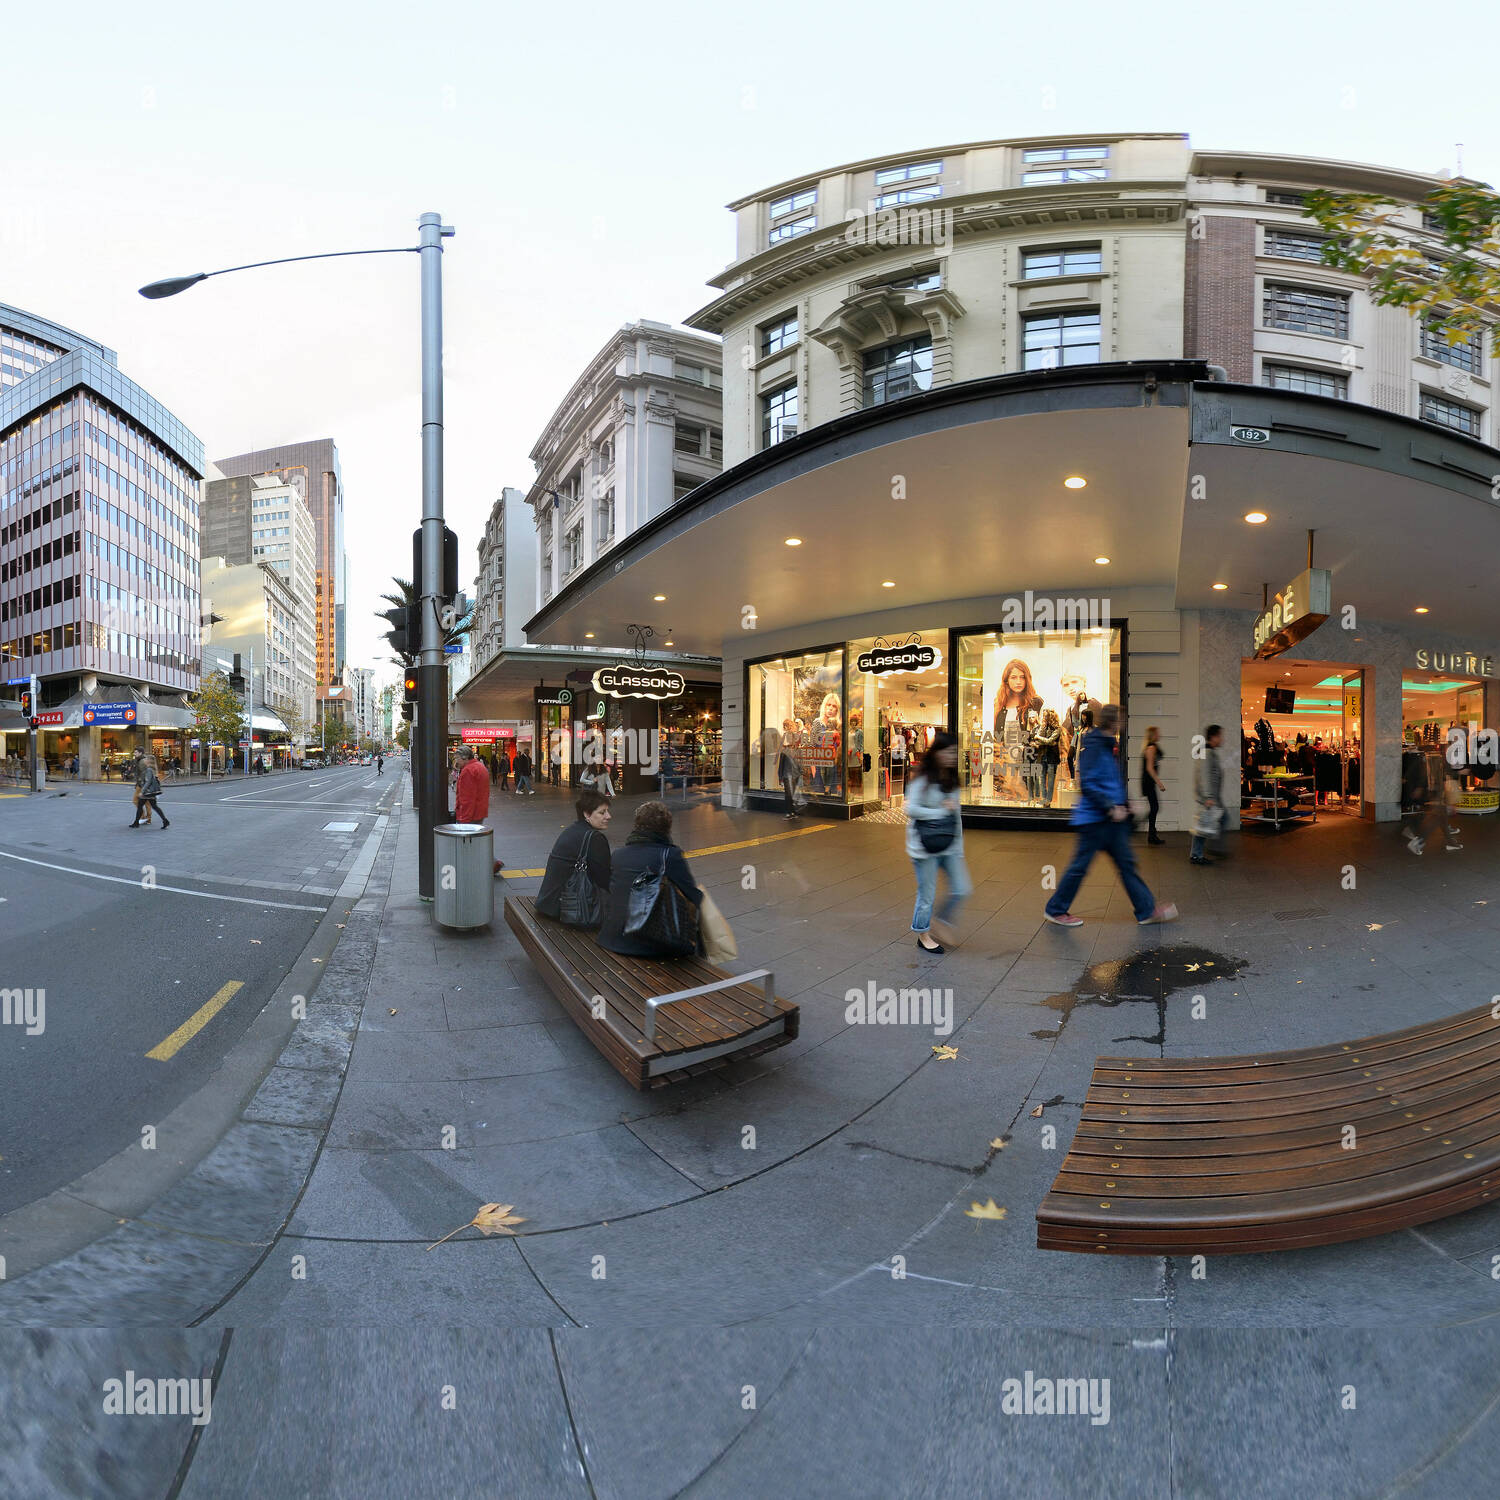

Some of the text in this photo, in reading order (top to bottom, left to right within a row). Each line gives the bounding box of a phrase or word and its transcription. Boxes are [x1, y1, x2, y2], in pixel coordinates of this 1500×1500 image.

[1241, 430, 1260, 440] 192
[1253, 585, 1294, 650] SUPRÉ
[860, 652, 932, 668] GLASSONS
[1416, 649, 1494, 677] SUPRÉ
[602, 675, 680, 689] GLASSONS
[971, 730, 1030, 744] LAYER
[1000, 746, 1039, 760] FOR
[971, 762, 1044, 777] WINTER
